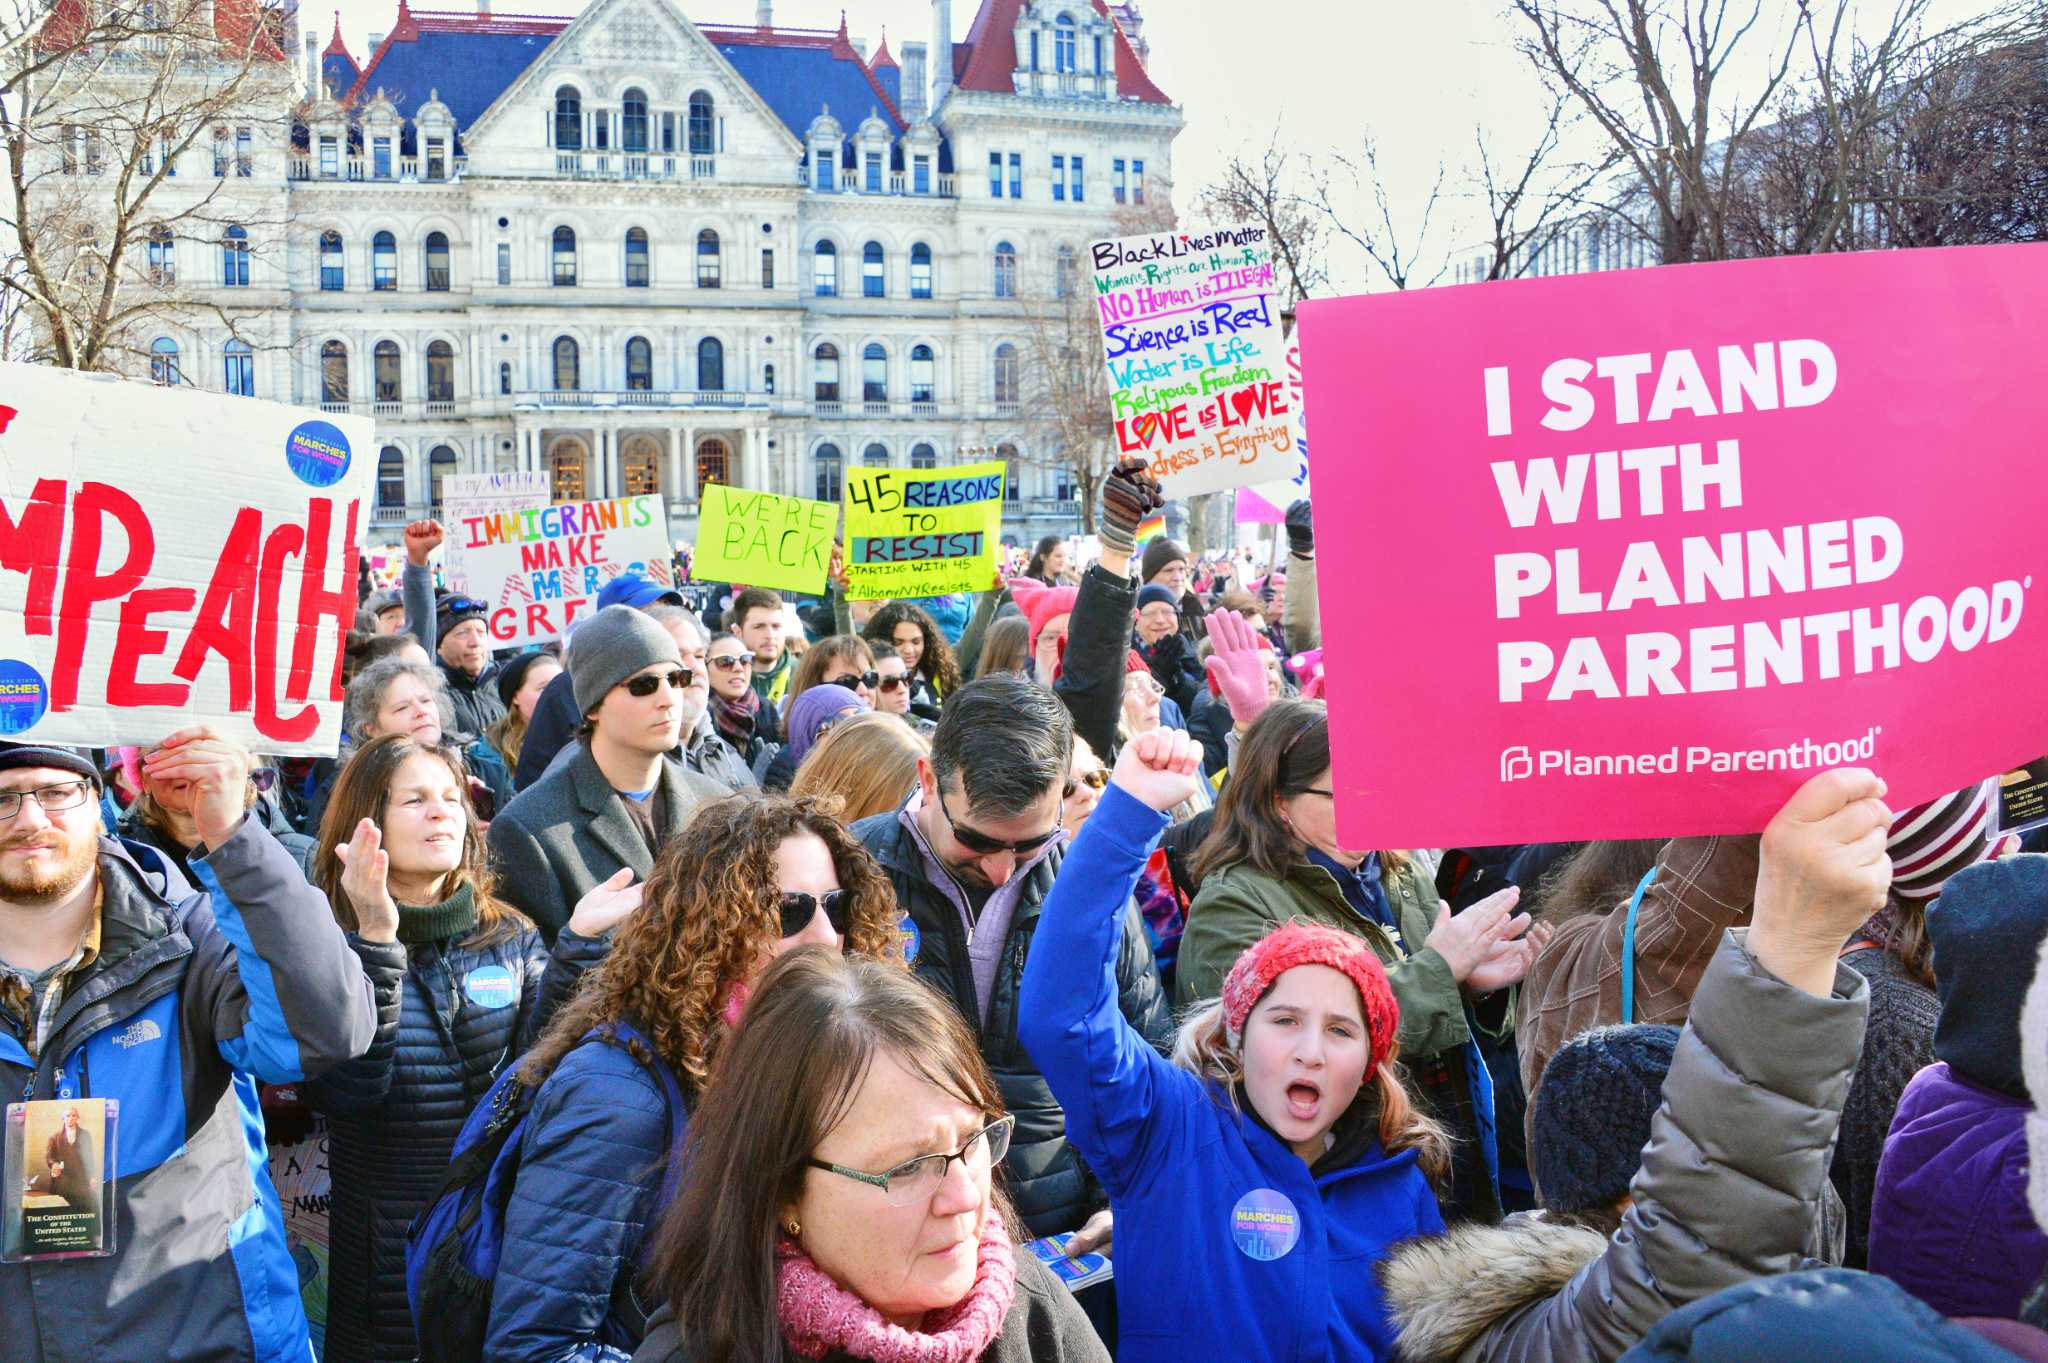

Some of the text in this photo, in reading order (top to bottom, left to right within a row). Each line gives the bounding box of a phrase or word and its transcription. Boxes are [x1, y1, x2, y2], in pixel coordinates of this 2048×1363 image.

[1092, 238, 1169, 270] Black
[1171, 234, 1214, 257] Lives
[1105, 295, 1273, 359] Science is Real
[1106, 336, 1261, 389] Water is Life
[1483, 338, 1838, 437] I STAND
[294, 435, 346, 459] MARCHES
[849, 474, 1002, 514] 45 REASONS
[1489, 438, 1744, 529] WITH
[463, 495, 652, 549] IMMIGRANTS
[722, 488, 826, 531] WE'RE
[903, 514, 937, 532] TO
[521, 534, 609, 573] MAKE
[722, 521, 827, 572] BACK
[864, 531, 984, 563] RESIST
[846, 559, 971, 576] STARTING WITH 45
[1494, 516, 1904, 619] PLANNED
[1539, 746, 1678, 777] Planned
[1236, 1211, 1294, 1225] MARCHES
